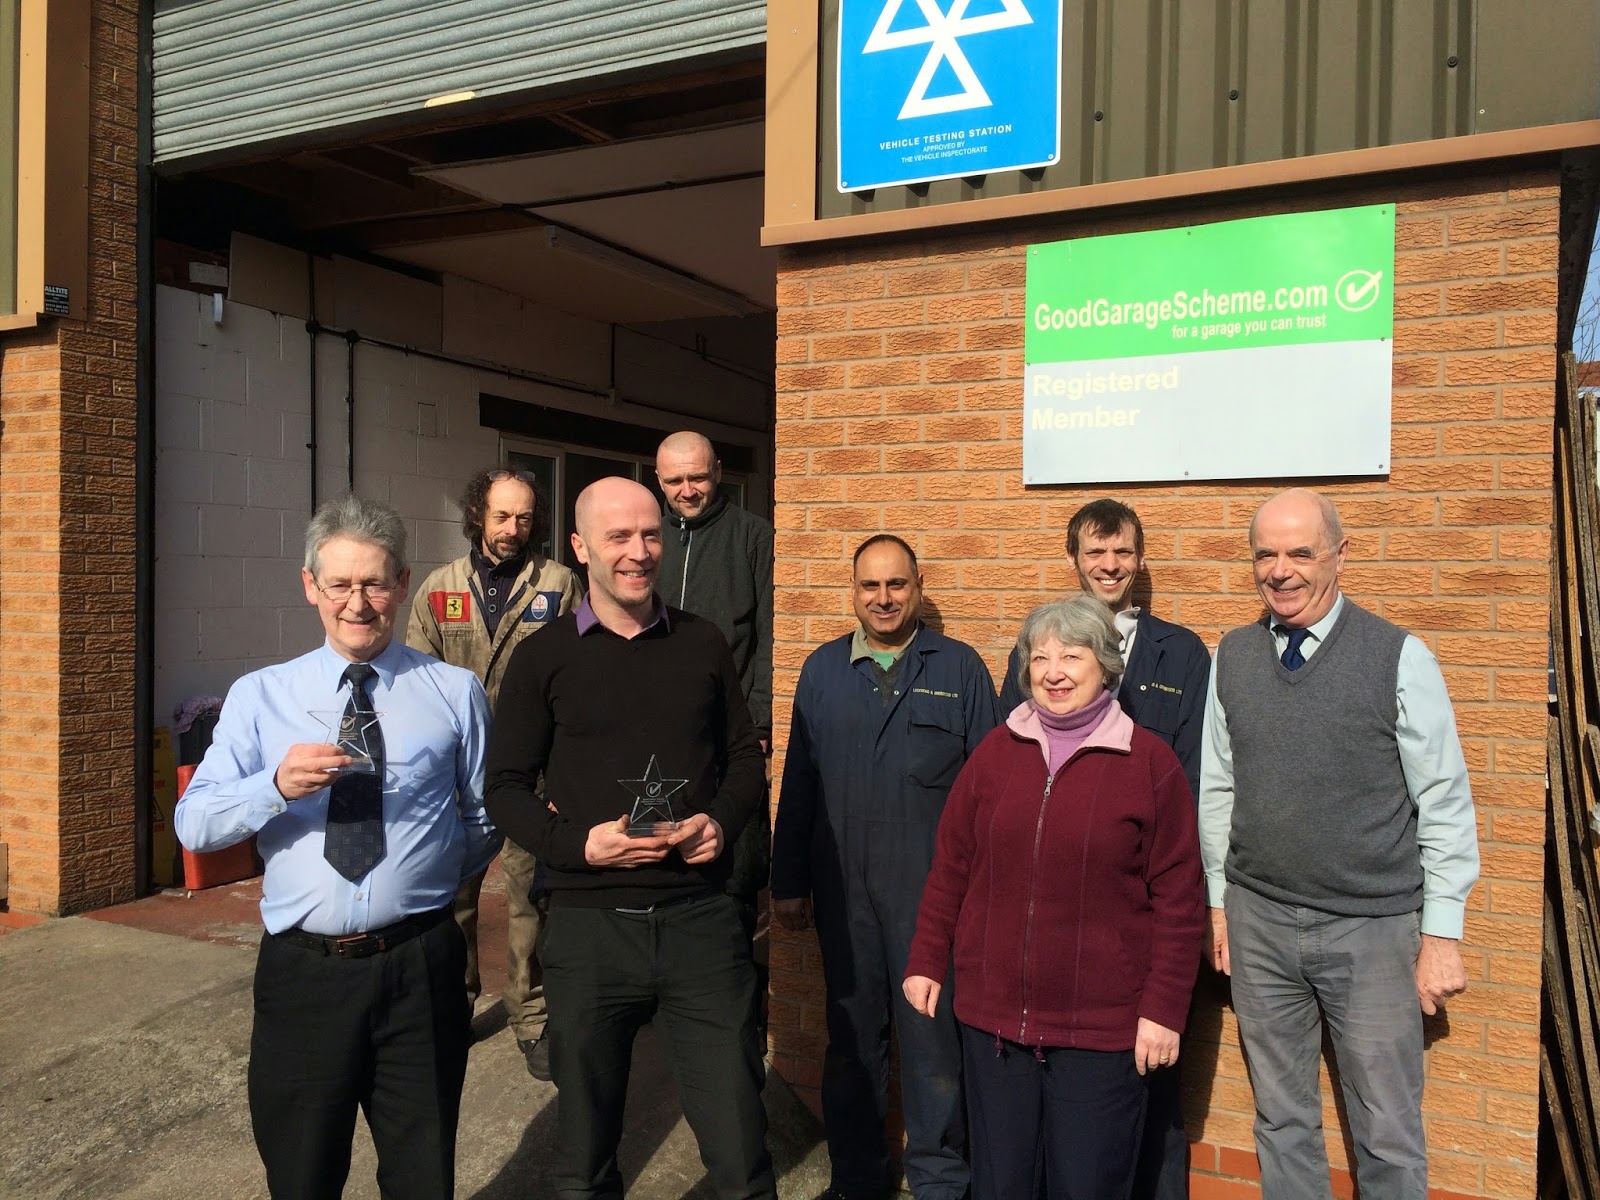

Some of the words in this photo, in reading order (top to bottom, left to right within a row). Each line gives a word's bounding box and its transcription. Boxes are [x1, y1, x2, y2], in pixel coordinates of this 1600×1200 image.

[880, 137, 920, 150] VEHICLE
[923, 131, 965, 144] TESTING
[969, 124, 1012, 137] STATION
[923, 142, 956, 153] APPROVED
[956, 141, 965, 149] BY
[901, 156, 913, 164] THE
[914, 152, 940, 162] VEHICLE
[940, 146, 988, 158] INSPECTORATE
[1034, 284, 1328, 331] GoodGarageScheme.com
[1172, 324, 1188, 339] for
[1191, 326, 1199, 338] a
[1201, 322, 1241, 340] garage
[1244, 318, 1267, 337] you
[1270, 317, 1293, 331] can
[1296, 313, 1327, 329] trust
[1032, 364, 1180, 401] Registered
[1031, 404, 1141, 430] Member
